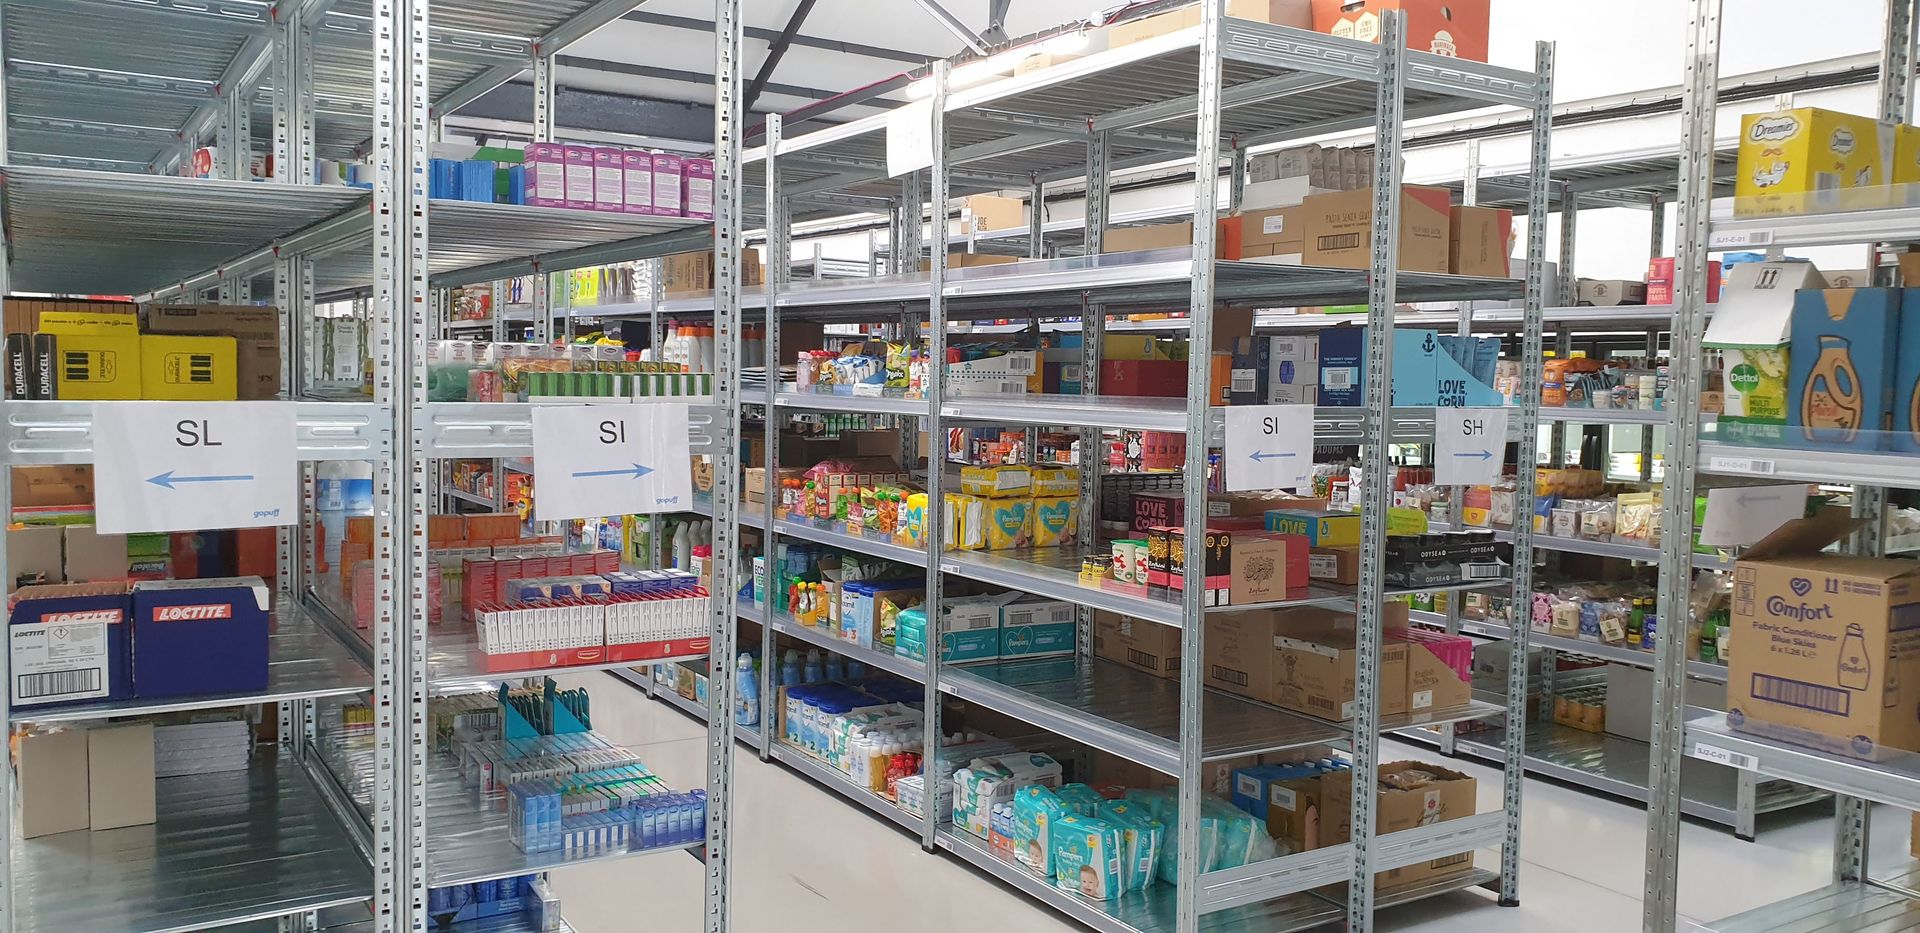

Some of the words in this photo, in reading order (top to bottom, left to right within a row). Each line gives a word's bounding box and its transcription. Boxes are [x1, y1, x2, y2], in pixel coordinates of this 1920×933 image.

[1754, 121, 1796, 138] Dreamies
[16, 351, 25, 396] DURACELL
[41, 351, 49, 396] DURACELL
[1730, 373, 1759, 383] Dettol
[175, 419, 223, 447] SL
[599, 419, 626, 445] SI
[1262, 416, 1279, 435] SI
[1462, 419, 1484, 436] SH
[253, 508, 280, 518] gopuff
[159, 606, 228, 621] LOCTITE
[1766, 595, 1834, 622] Comfort
[14, 629, 47, 638] LOCTITE
[1752, 621, 1781, 633] Fabric
[1782, 626, 1838, 642] Conditioner
[1771, 634, 1791, 645] Blue
